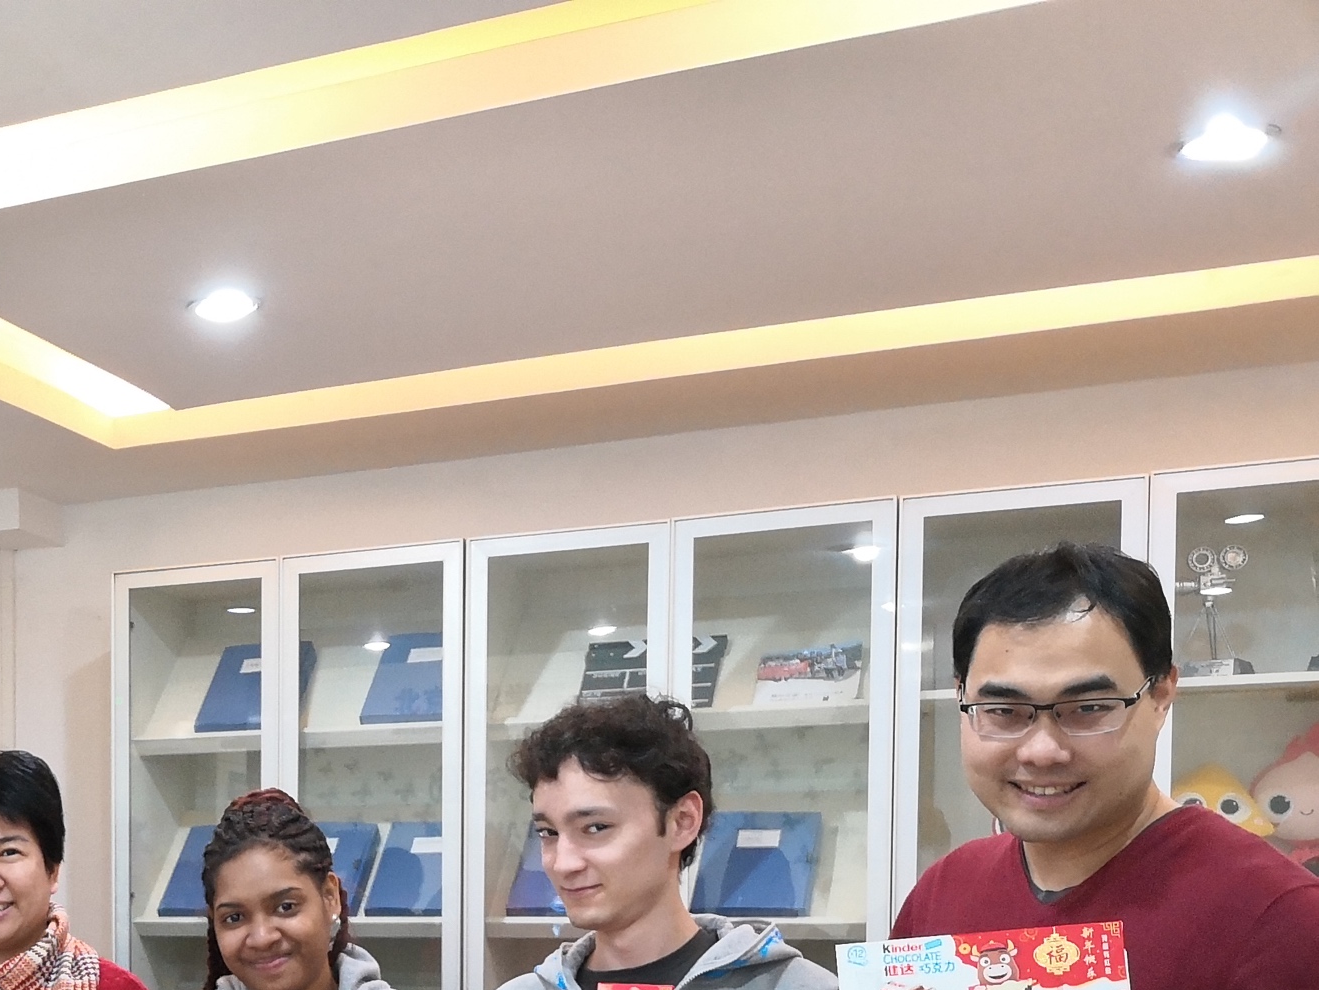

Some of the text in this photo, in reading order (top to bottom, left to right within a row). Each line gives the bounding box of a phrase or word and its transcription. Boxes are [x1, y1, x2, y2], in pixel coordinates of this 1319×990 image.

[882, 943, 923, 954] Kinder
[1047, 944, 1069, 965] 福
[1080, 926, 1097, 979] 新年快乐
[883, 951, 941, 965] CHOCOLATE
[884, 961, 955, 977] 健达 巧克力
